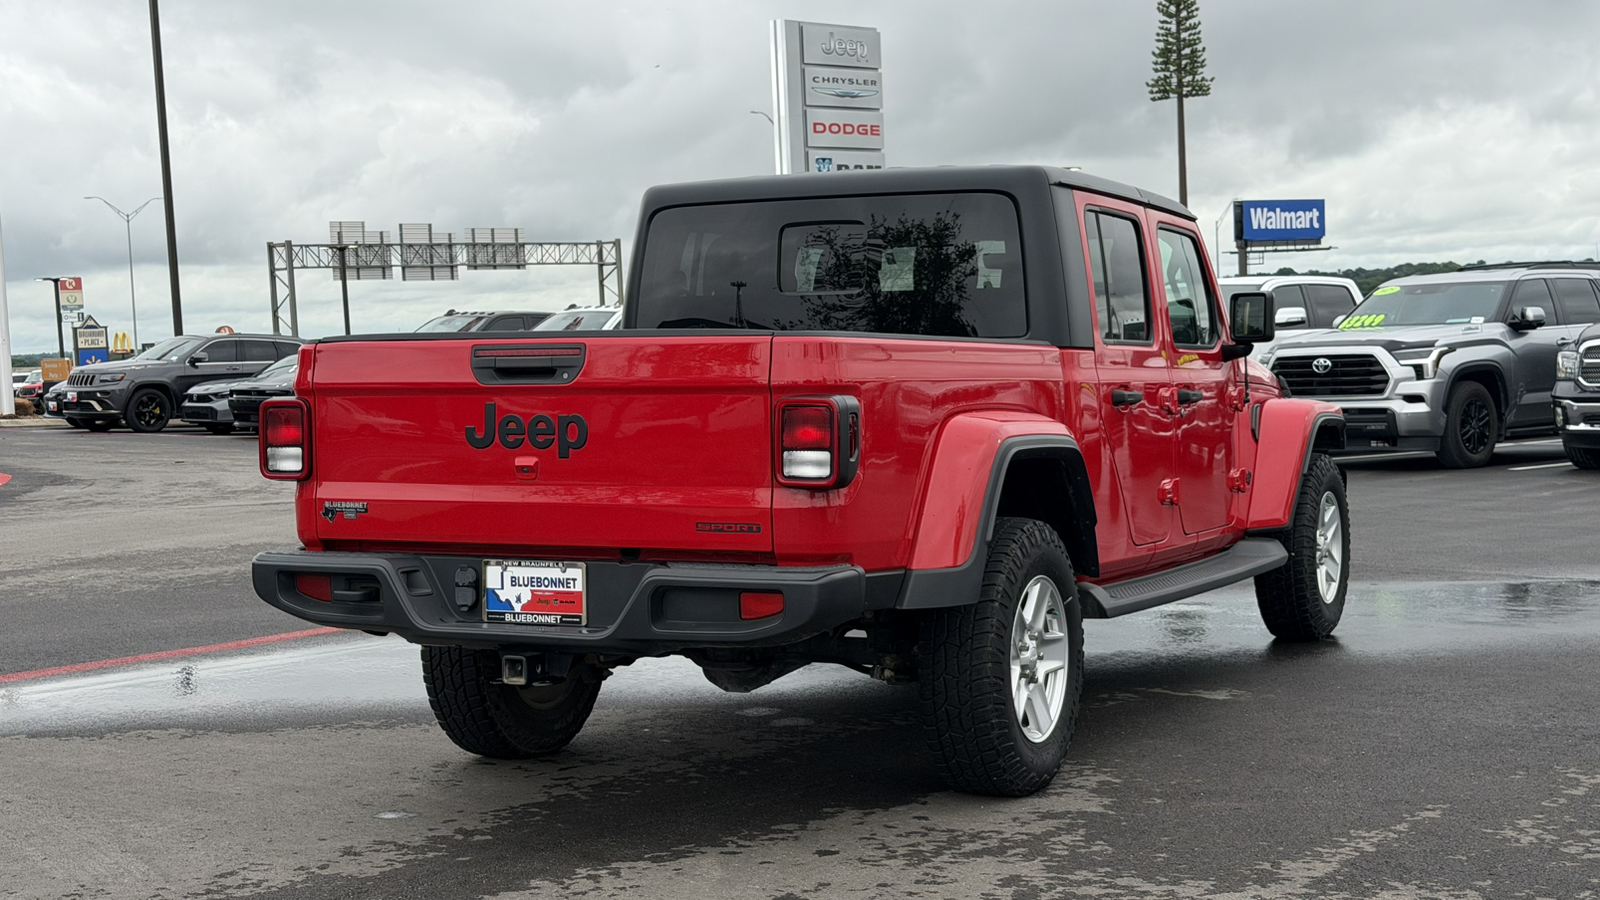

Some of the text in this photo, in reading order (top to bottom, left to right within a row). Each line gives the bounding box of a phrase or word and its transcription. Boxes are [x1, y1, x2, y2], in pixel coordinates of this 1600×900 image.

[821, 32, 868, 62] Jeep
[812, 76, 877, 87] CHRYSLER
[812, 122, 881, 136] DODGE
[1249, 207, 1320, 229] Walmart
[465, 402, 589, 459] Jeep
[696, 522, 761, 533] SPORT
[510, 576, 577, 589] BLUEBONNET
[505, 613, 561, 623] BLUEBONNET
